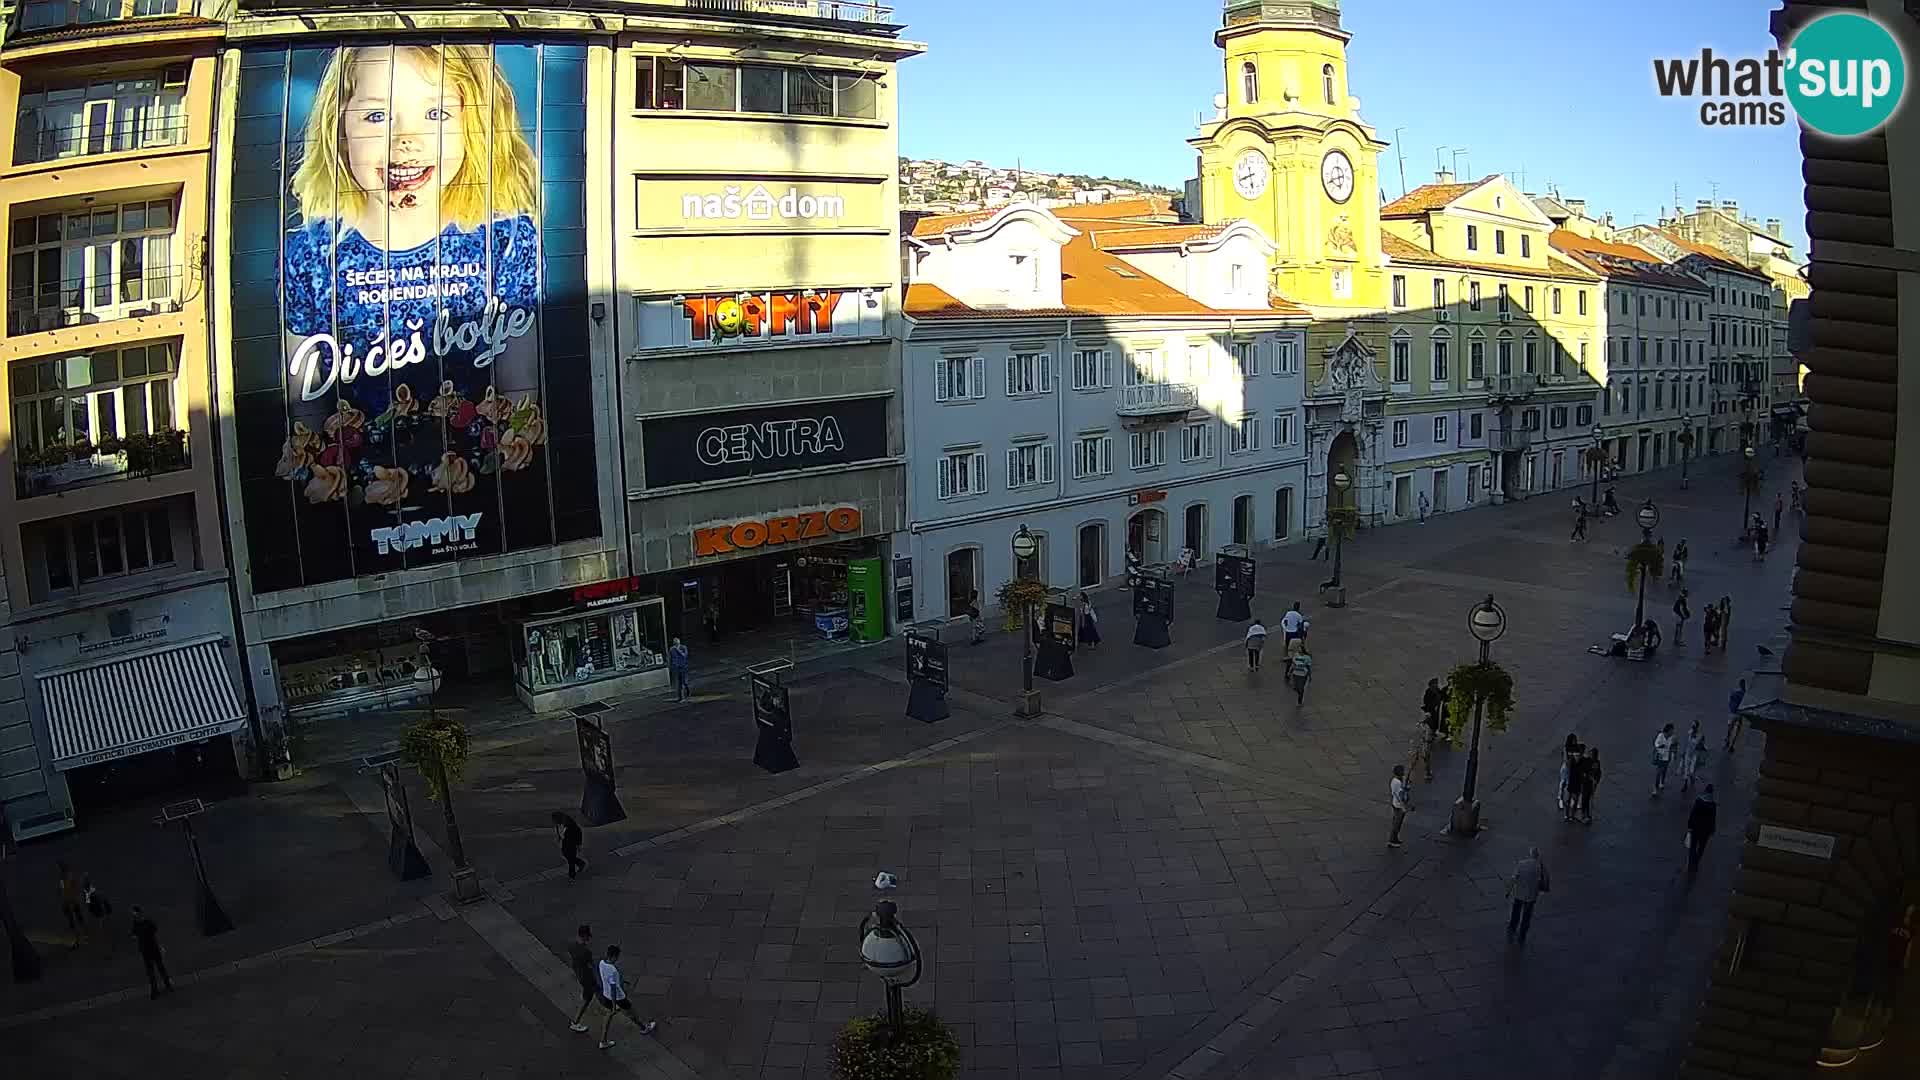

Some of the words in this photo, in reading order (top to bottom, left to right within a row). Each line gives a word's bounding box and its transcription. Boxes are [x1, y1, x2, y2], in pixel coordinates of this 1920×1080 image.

[682, 184, 742, 218] naš
[778, 187, 845, 218] dom
[401, 266, 423, 281] NA
[429, 262, 480, 280] KRAJU
[289, 333, 361, 402] Di
[364, 318, 426, 376] ćeš
[433, 295, 535, 368] bolje
[696, 416, 845, 466] CENTRA
[371, 512, 483, 555] TOMMY
[693, 507, 862, 557] KORZO
